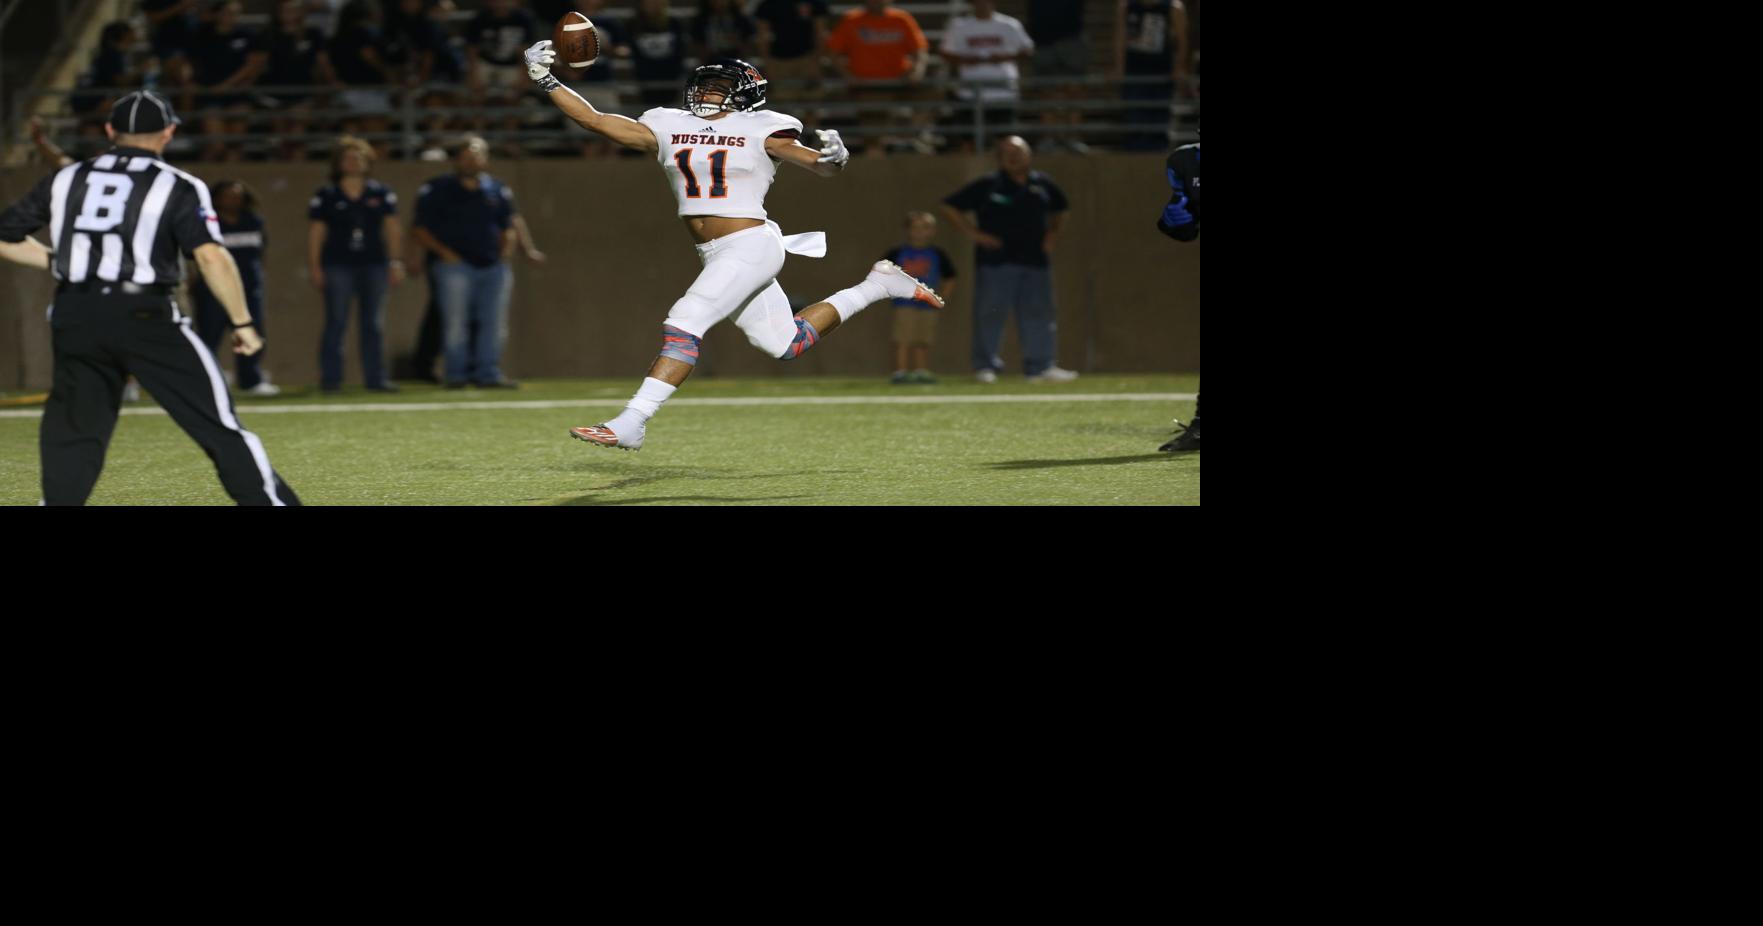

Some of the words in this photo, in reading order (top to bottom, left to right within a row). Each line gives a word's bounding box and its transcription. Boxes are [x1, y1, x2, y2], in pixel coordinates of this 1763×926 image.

[671, 134, 746, 147] MUSTANGS
[673, 148, 728, 198] 11
[74, 171, 134, 231] B
